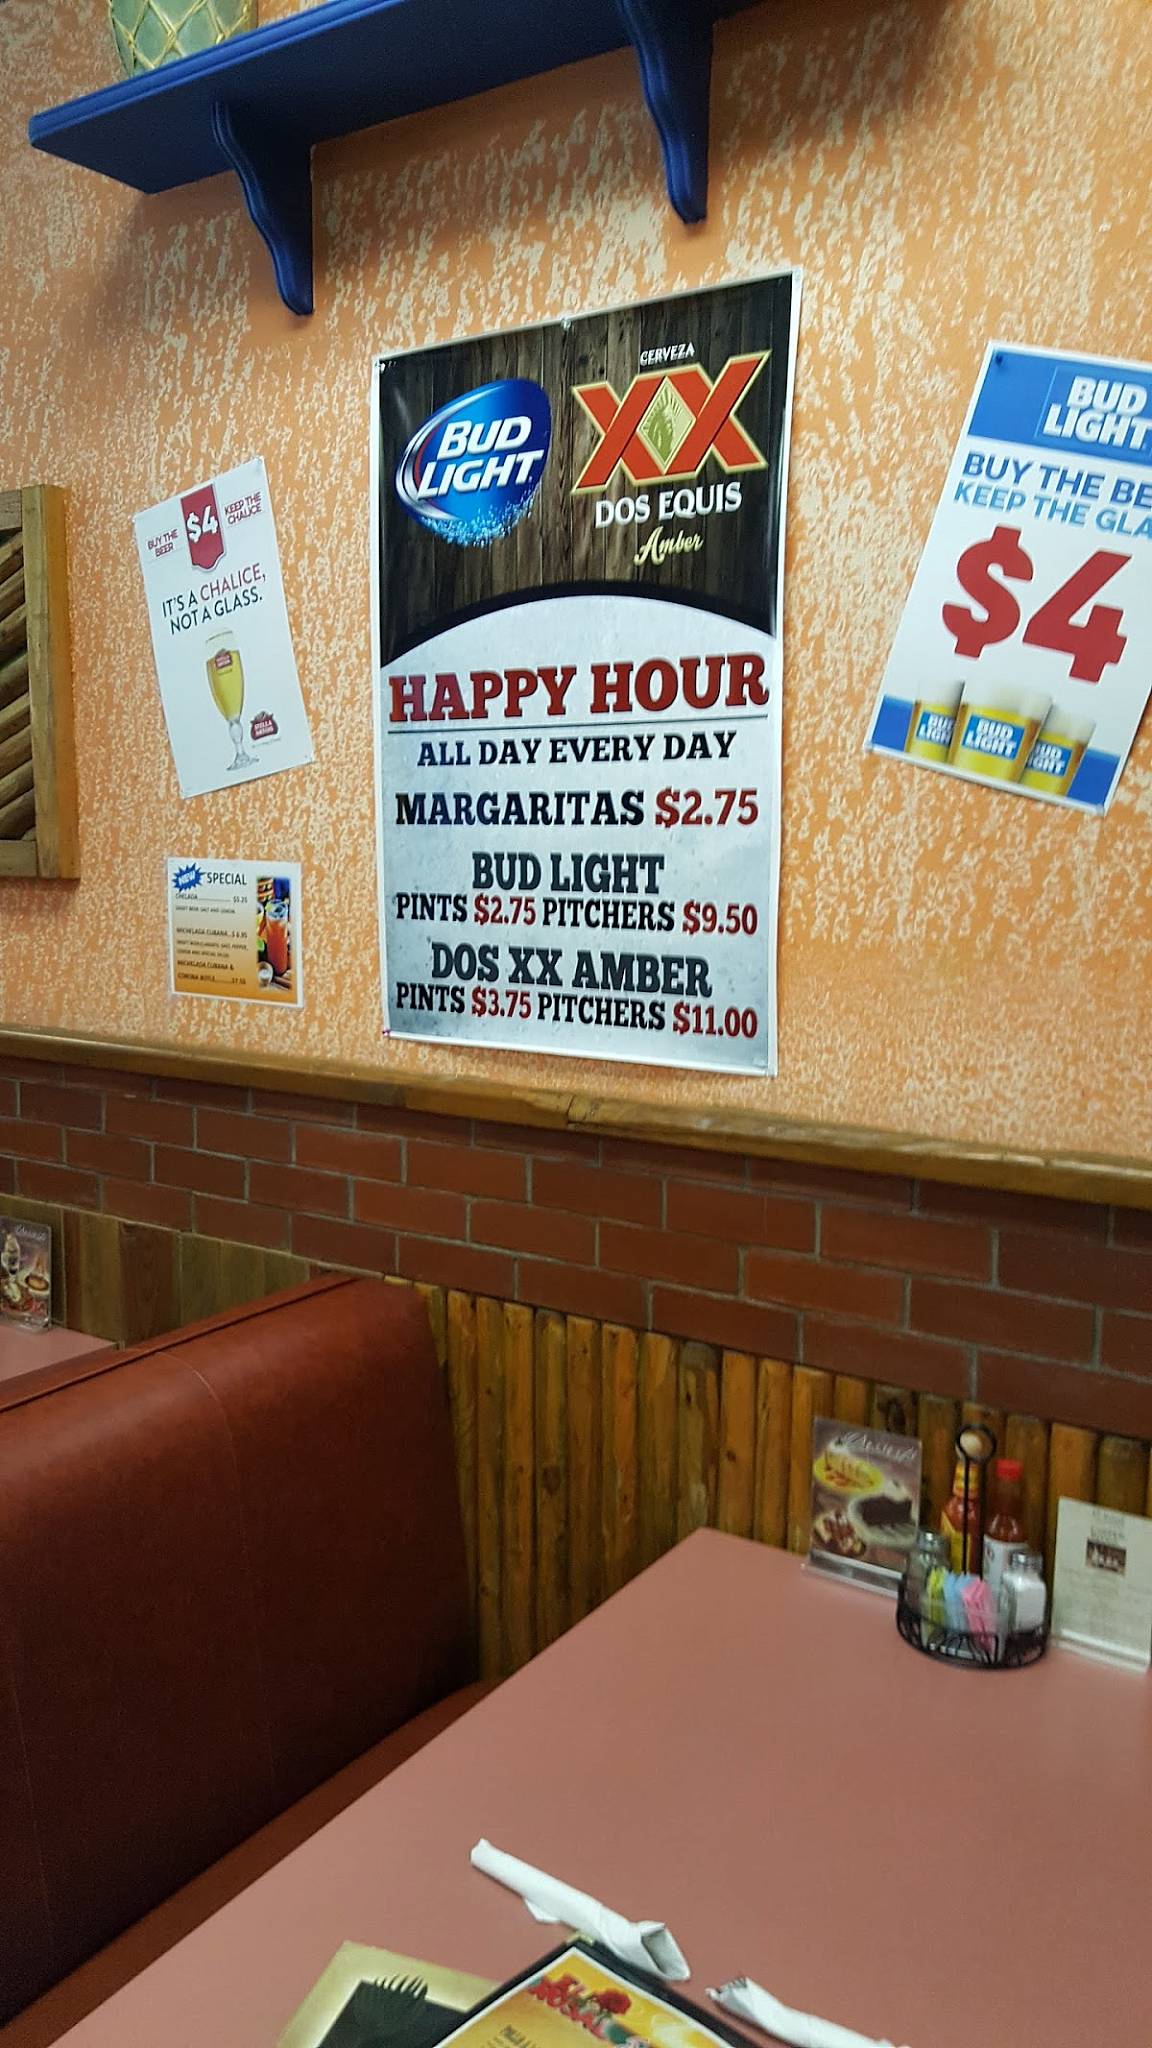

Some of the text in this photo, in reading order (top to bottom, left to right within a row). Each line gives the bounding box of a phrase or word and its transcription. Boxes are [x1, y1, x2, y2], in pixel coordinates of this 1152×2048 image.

[640, 342, 695, 366] CERVEZA
[1066, 375, 1148, 417] BUD
[437, 416, 531, 460] BUD
[1042, 403, 1152, 450] LIGHT
[416, 450, 544, 498] LIGHT
[962, 452, 1035, 485] BUY
[1040, 464, 1105, 499] THE
[186, 505, 218, 543] $4
[224, 492, 261, 516] KEEP THE
[227, 503, 262, 525] CHALICE
[595, 482, 742, 528] DOS EQUIS
[953, 480, 1026, 513] KEEP
[1033, 495, 1090, 525] THE
[147, 528, 179, 550] BUY THE
[155, 542, 174, 557] BEER
[634, 525, 704, 567] Amber
[162, 563, 266, 618] IT'S A CHALICE,
[170, 586, 262, 635] NOT A GLASS.
[942, 526, 1133, 684] $4
[388, 653, 770, 722] HAPPY HOUR
[417, 730, 736, 767] ALL DAY EVERY DAY
[965, 730, 1017, 757] LIGHT
[395, 787, 759, 828] MARGARITAS $2.75
[207, 872, 247, 885] SPECIAL
[472, 851, 664, 894] BUD LIGHT
[396, 892, 758, 936] PINTS $2.75 PITCHERS $9.50
[431, 942, 713, 998] DOS XX AMBER
[396, 982, 758, 1038] PINTS $3.75 PITCHERS $11.00
